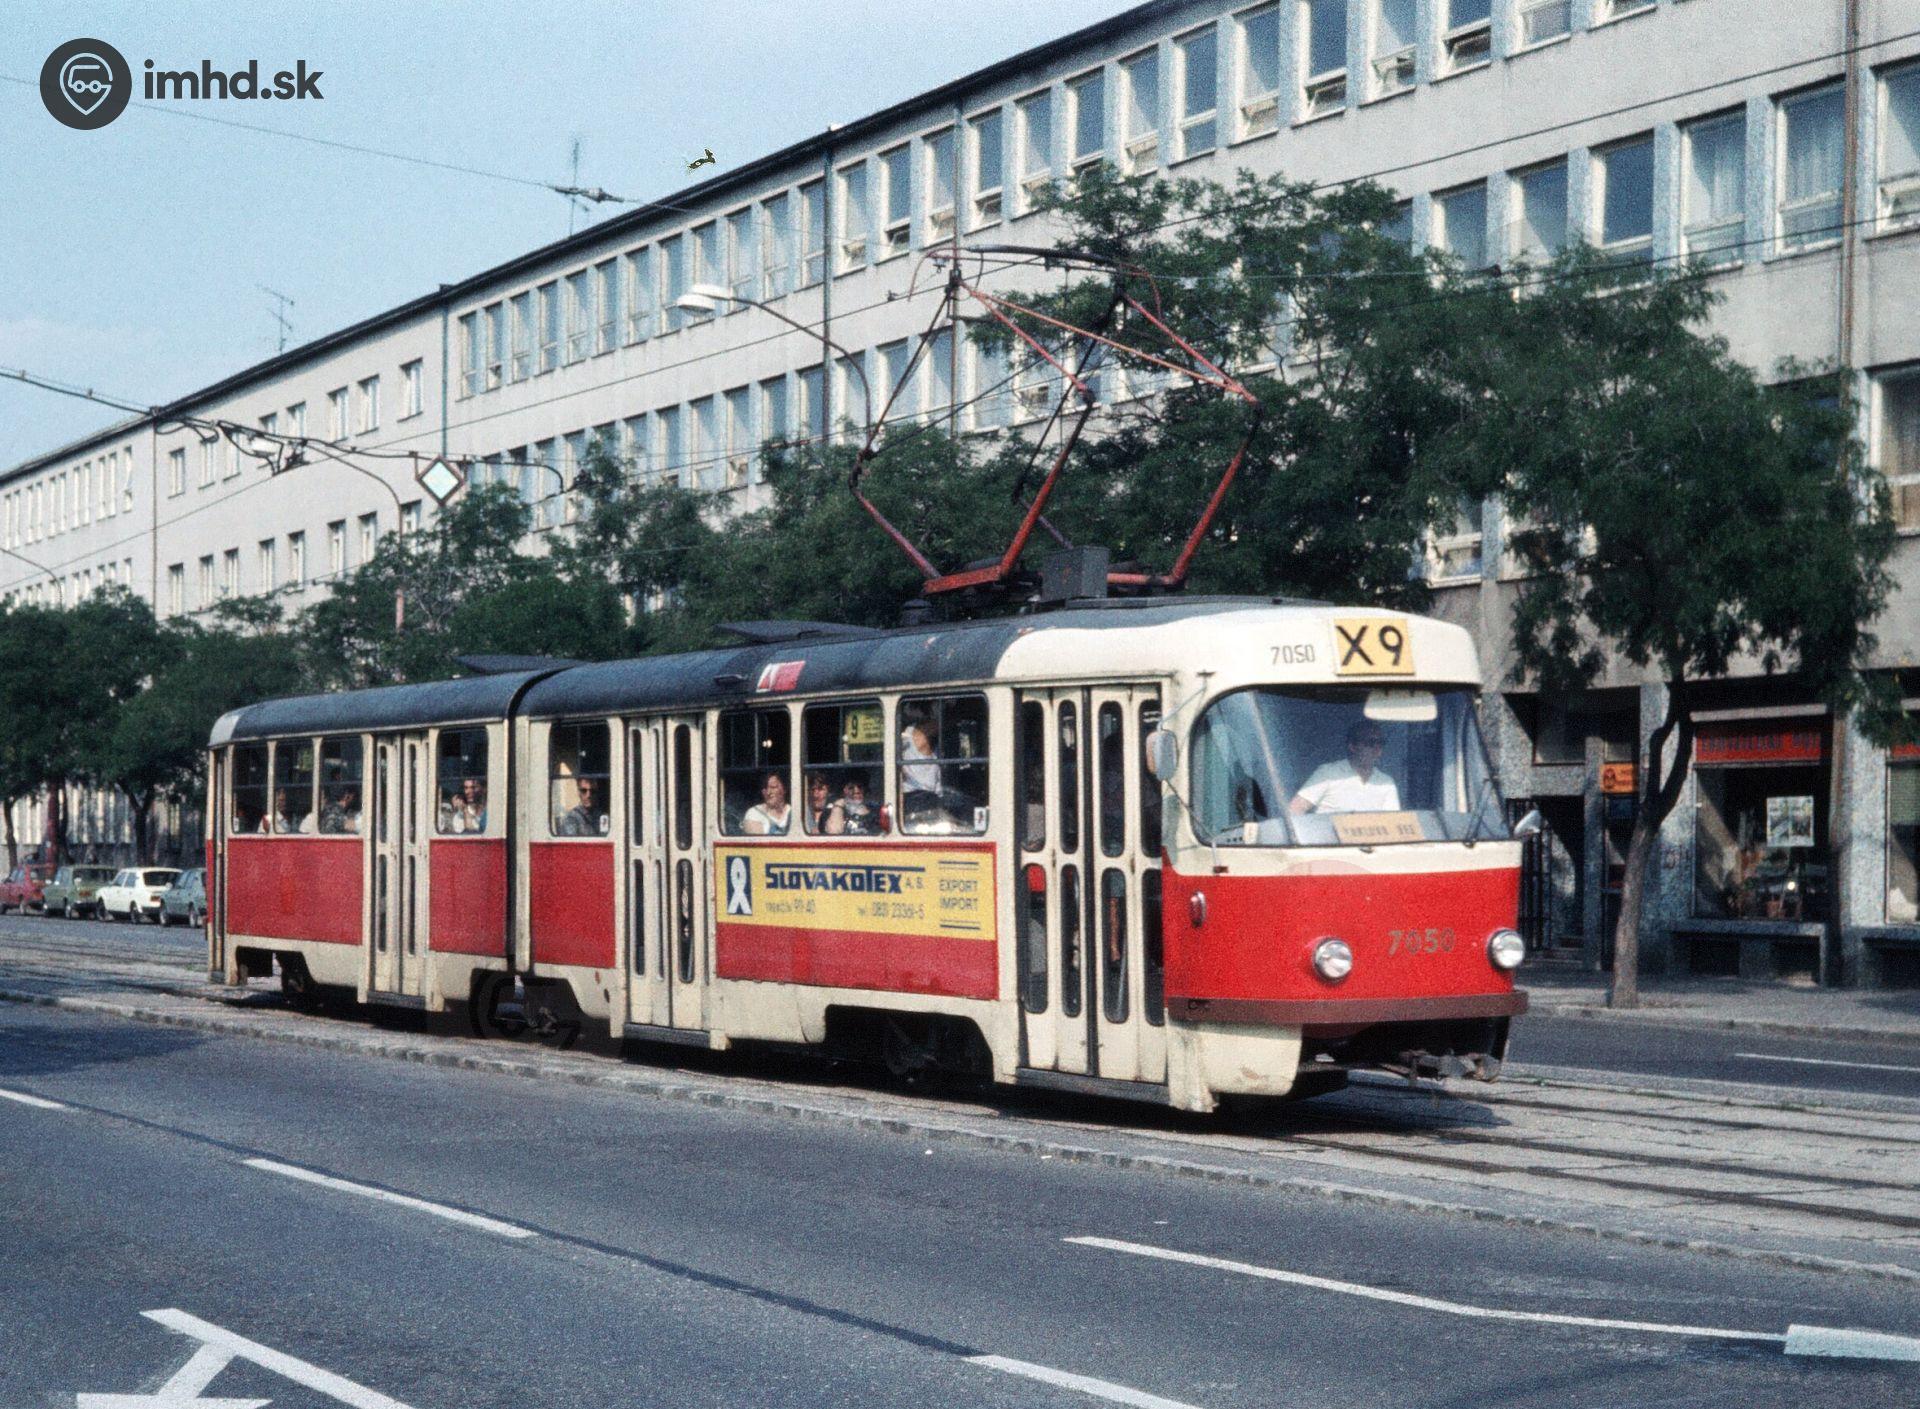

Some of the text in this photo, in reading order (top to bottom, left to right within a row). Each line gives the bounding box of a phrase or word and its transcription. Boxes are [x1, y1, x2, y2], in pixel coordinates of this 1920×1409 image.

[1270, 644, 1316, 665] 7050
[851, 714, 859, 739] 9
[939, 879, 979, 894] EXPORT
[939, 896, 979, 911] IMPORT
[1387, 927, 1457, 958] 7050
